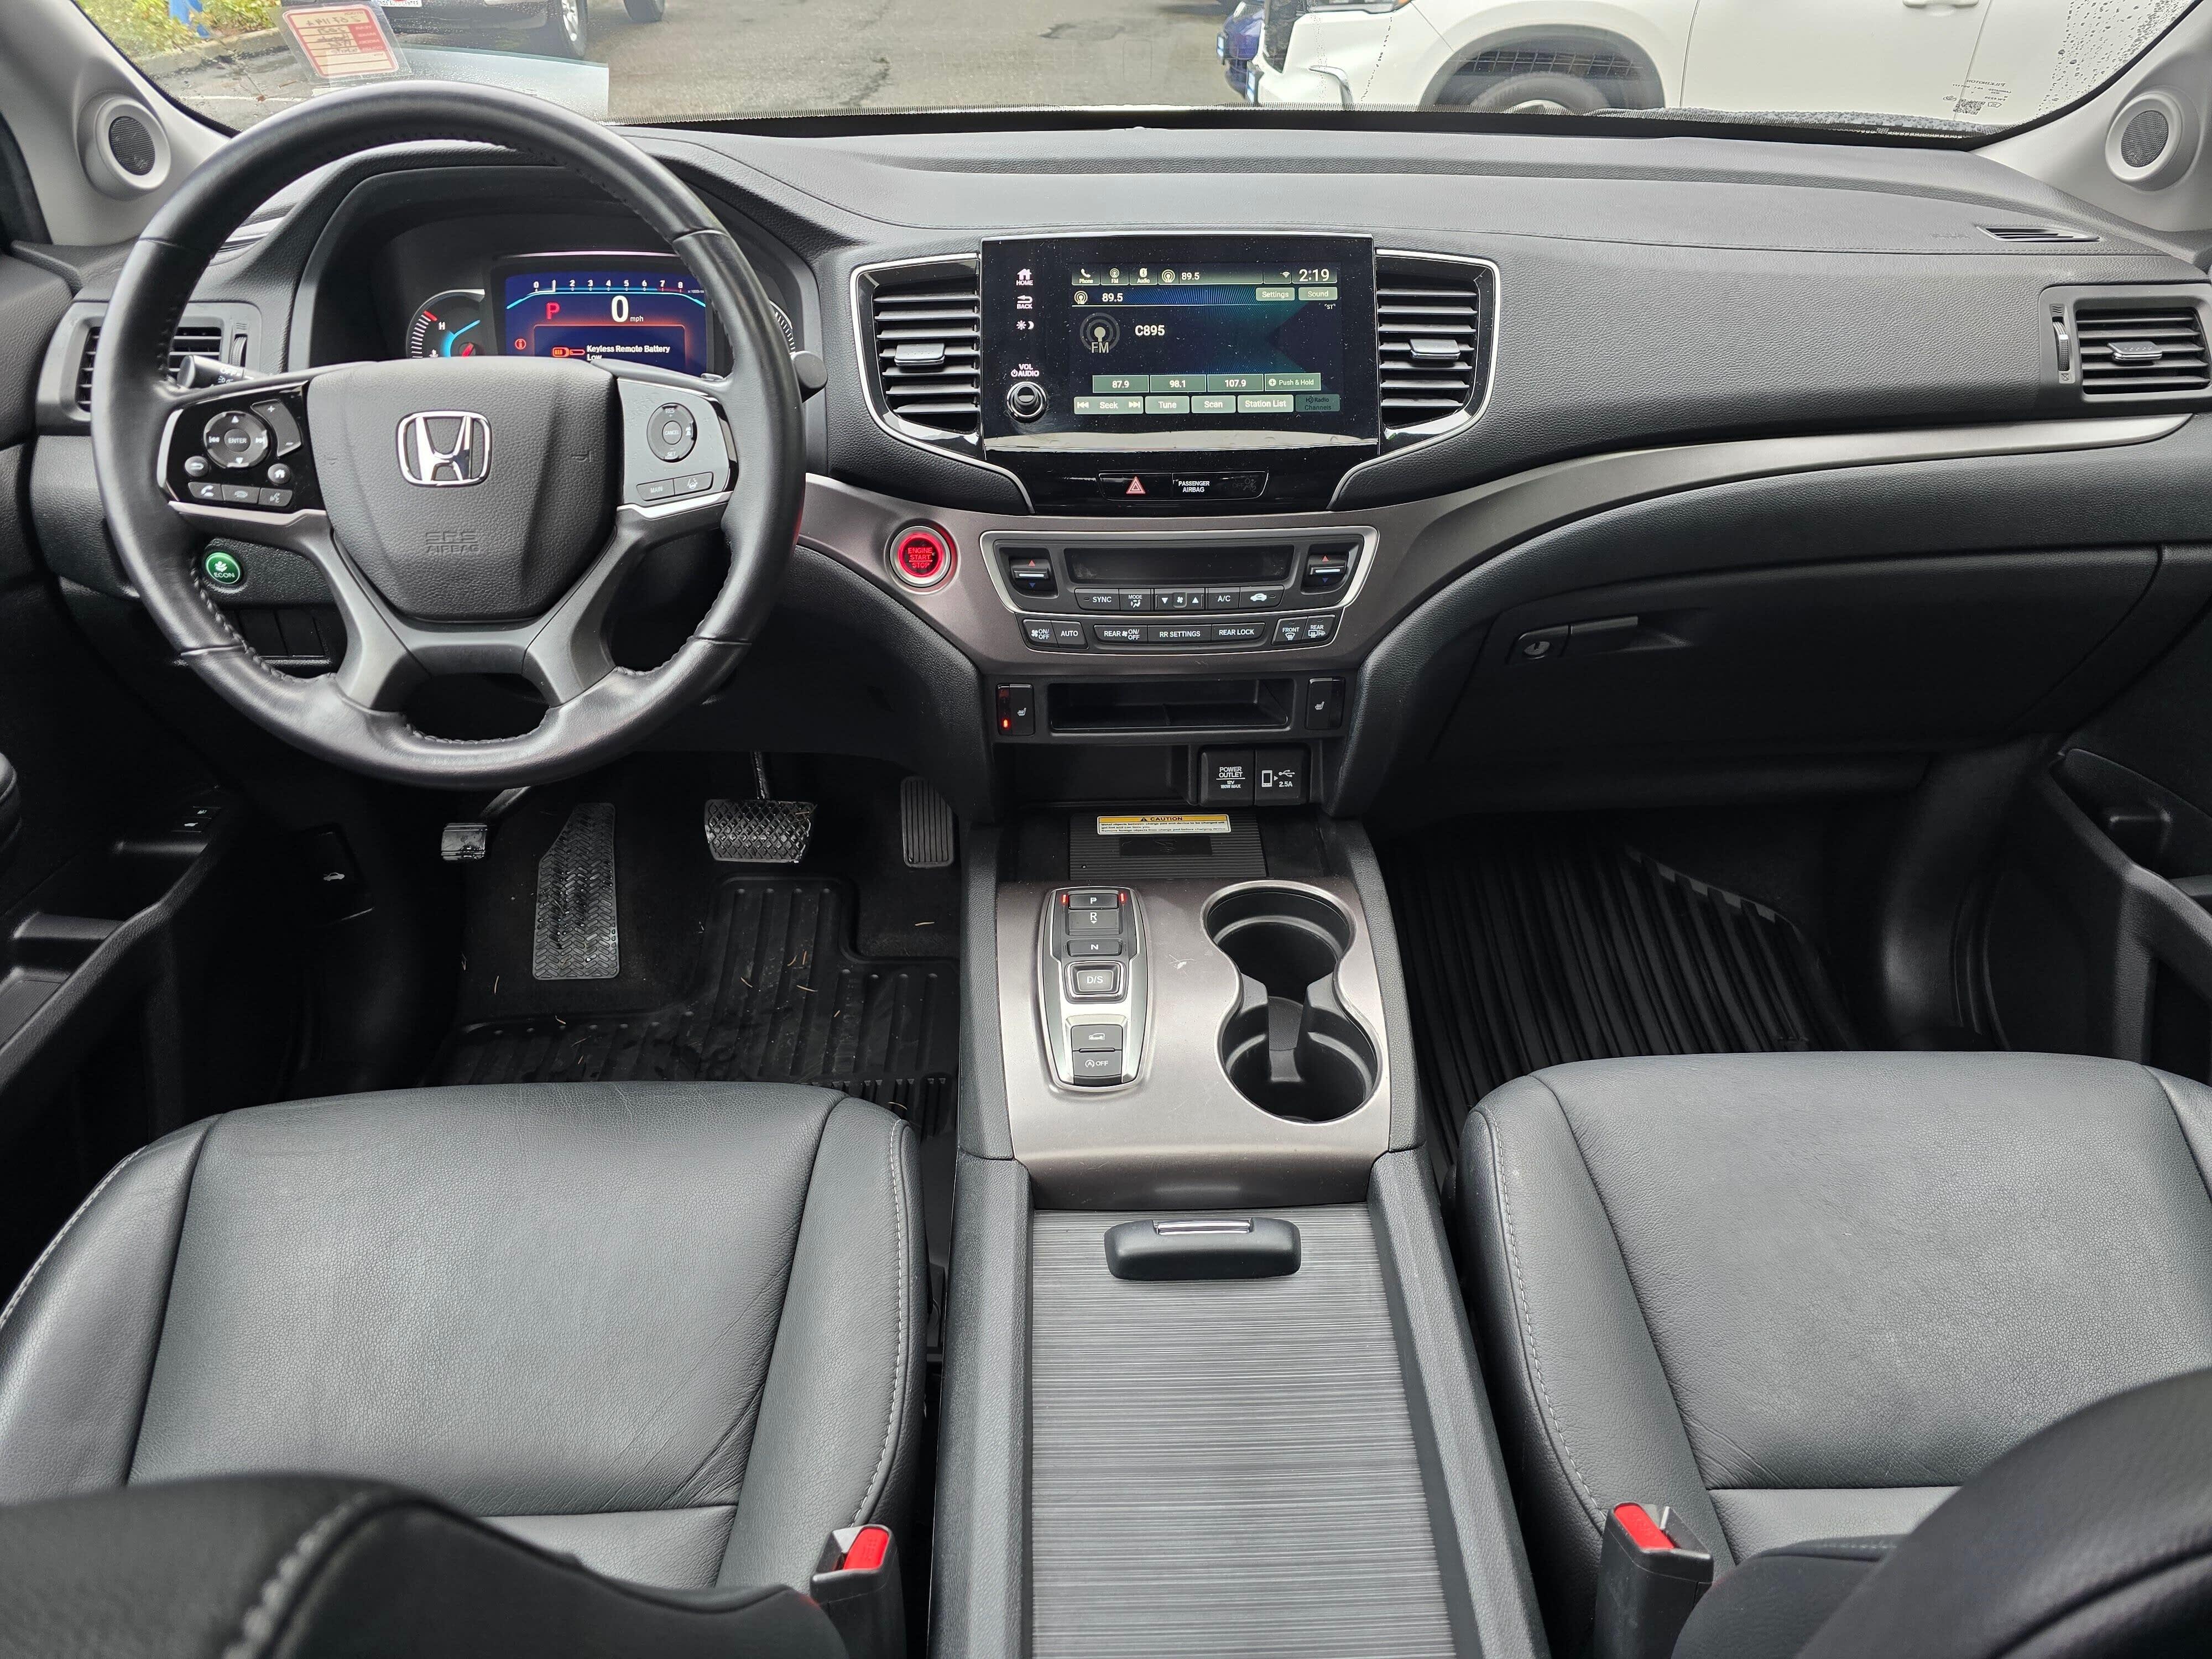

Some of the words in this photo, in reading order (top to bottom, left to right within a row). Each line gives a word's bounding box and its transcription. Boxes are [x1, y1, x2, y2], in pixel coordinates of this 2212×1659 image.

[1181, 272, 1200, 280] 89.5
[1299, 269, 1329, 282] 2:19
[1102, 293, 1123, 302] 89.5
[546, 302, 560, 320] P
[611, 295, 629, 322] 0
[439, 321, 446, 330] H
[1135, 325, 1165, 336] C895
[644, 345, 670, 353] Battery
[1091, 342, 1109, 353] FM
[1112, 380, 1129, 388] 87.9
[1090, 912, 1097, 921] R
[1086, 975, 1103, 984] D/S
